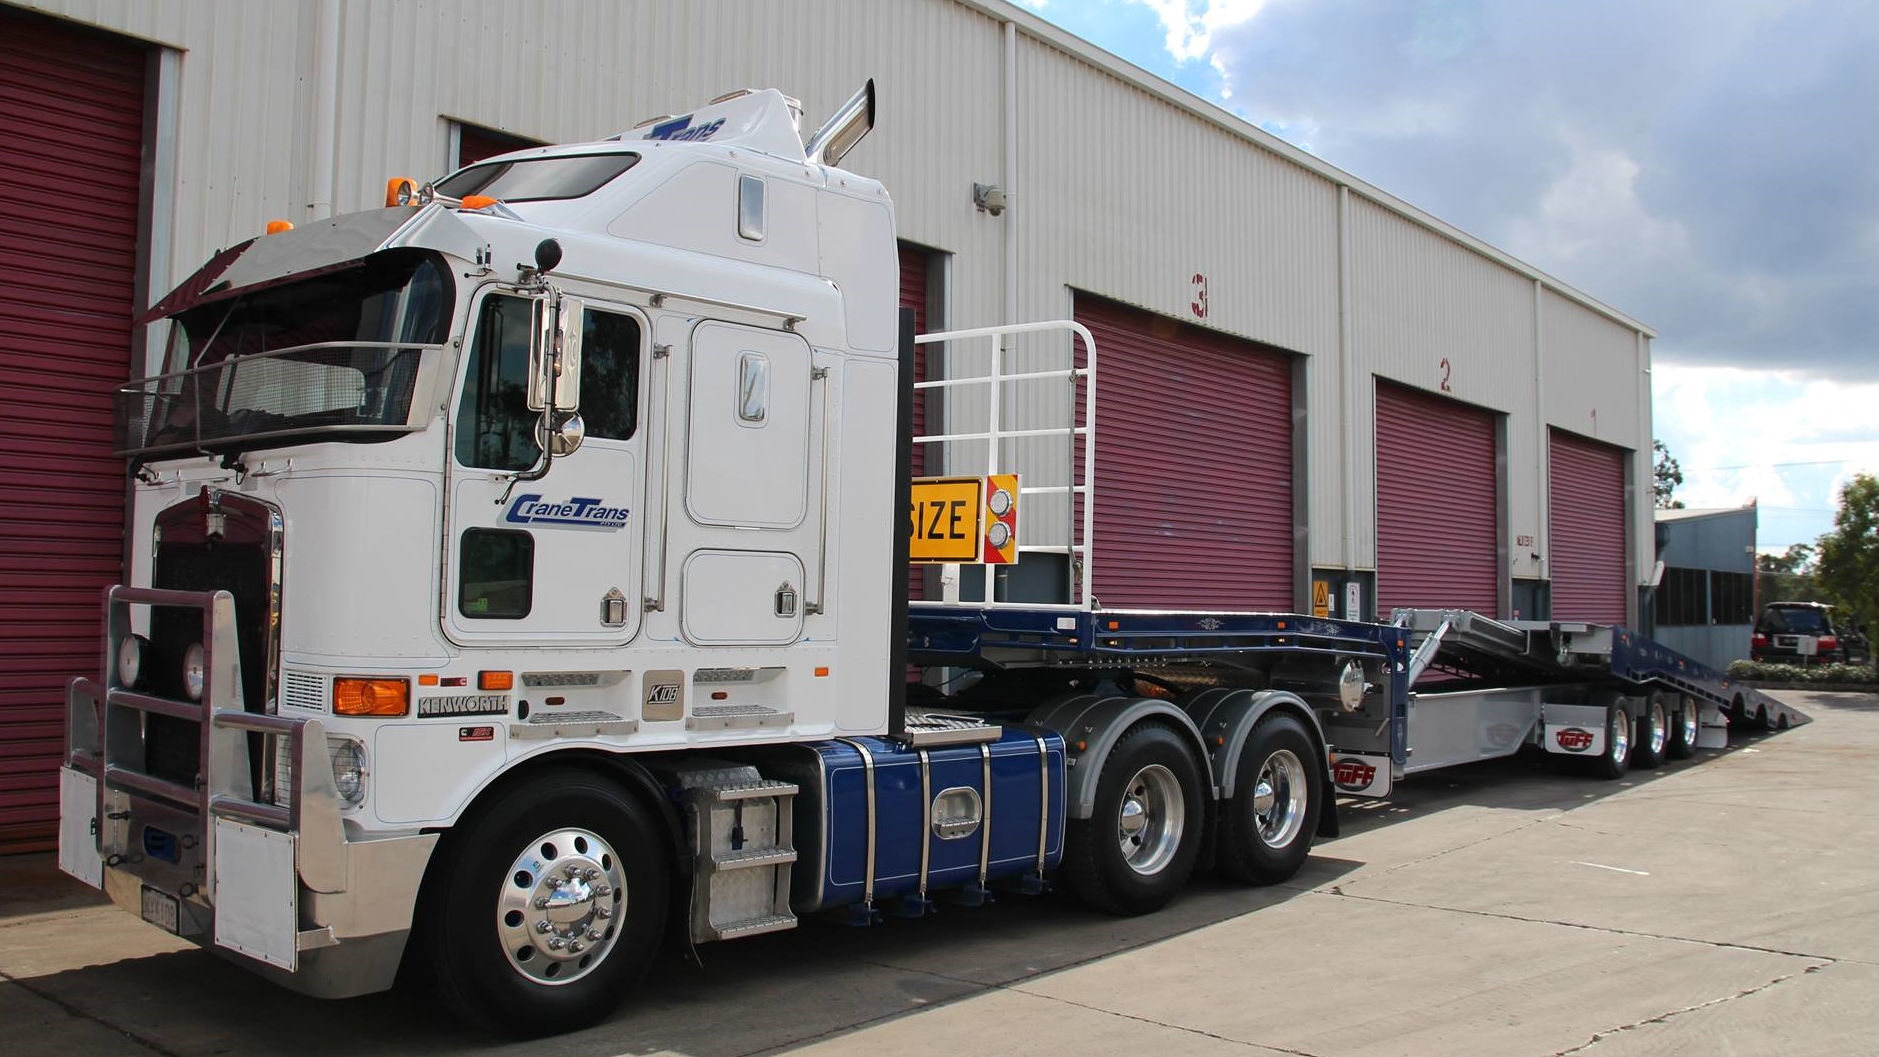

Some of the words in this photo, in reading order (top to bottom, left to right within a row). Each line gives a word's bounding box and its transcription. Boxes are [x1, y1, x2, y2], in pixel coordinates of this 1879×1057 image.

[1191, 273, 1208, 318] 3
[1440, 358, 1451, 392] 2
[418, 696, 509, 714] KENWORTH
